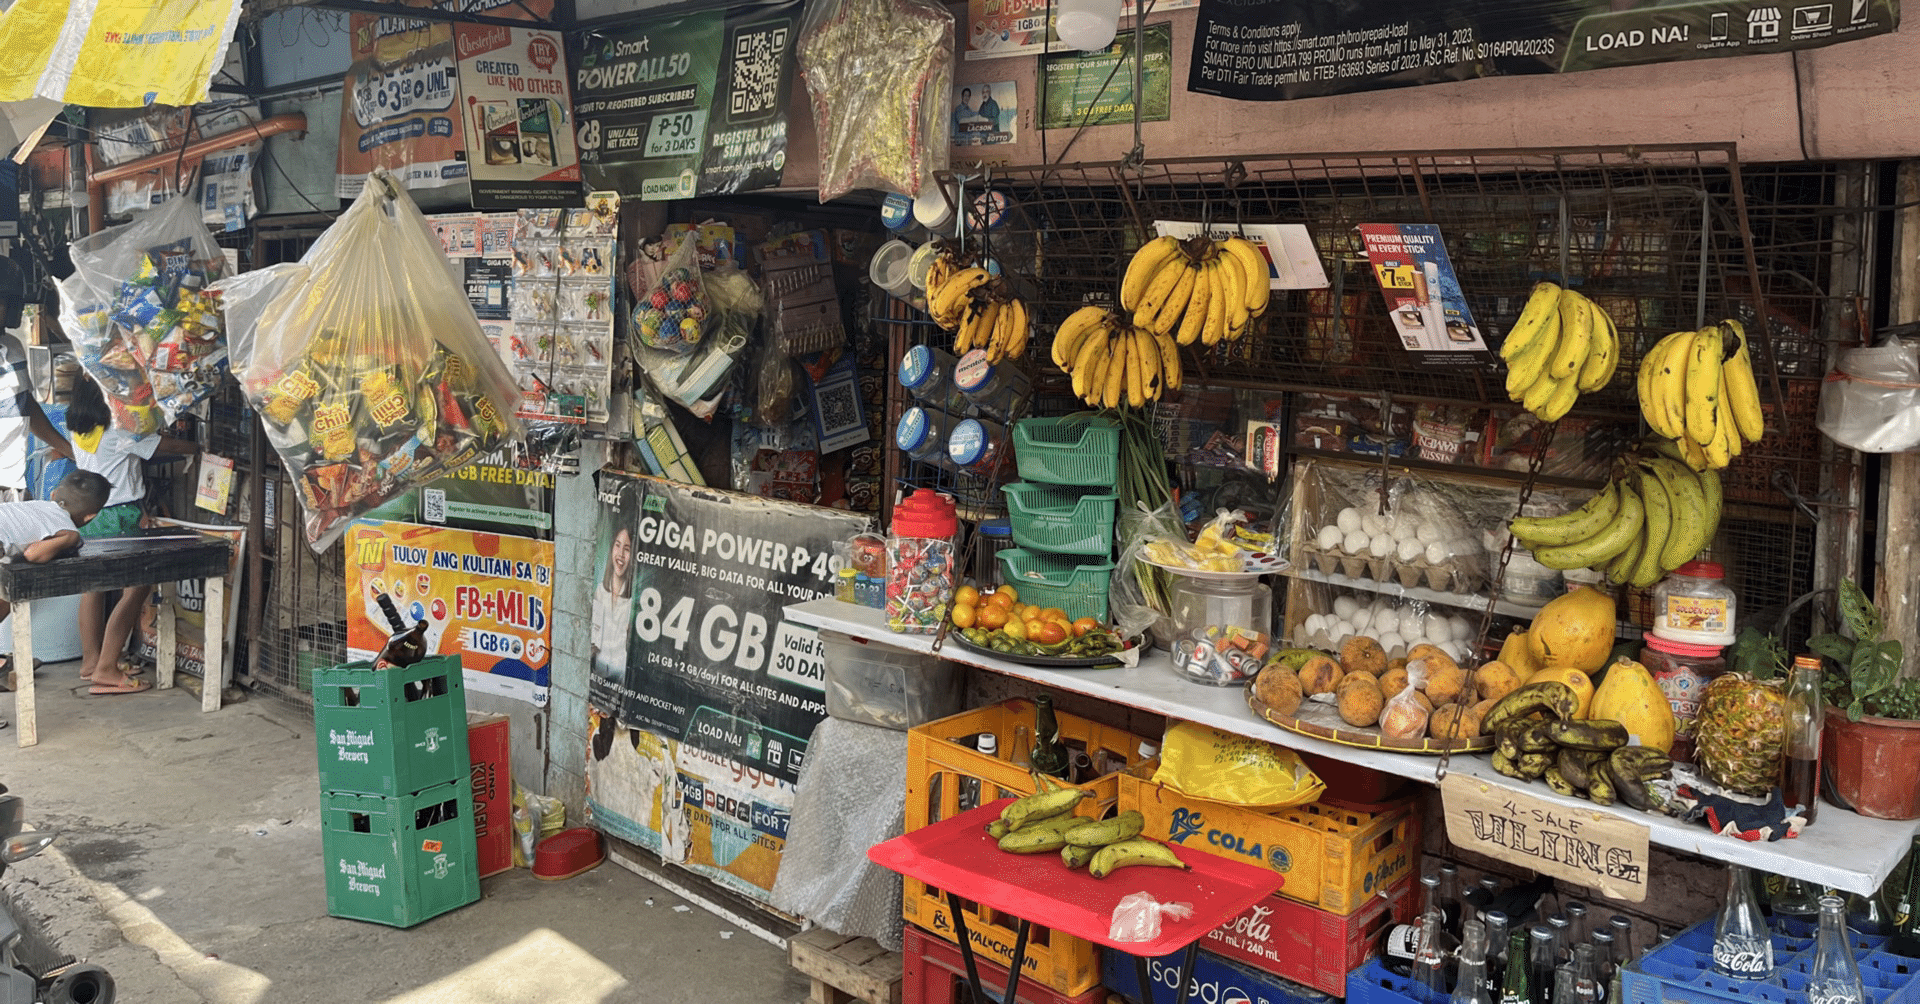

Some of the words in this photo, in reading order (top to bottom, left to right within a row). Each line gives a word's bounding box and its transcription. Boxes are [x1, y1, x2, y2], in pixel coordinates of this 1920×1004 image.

[1208, 20, 1231, 37] Terms
[1232, 25, 1239, 38] &
[1240, 25, 1280, 39] Conditions
[1281, 20, 1302, 37] apply.
[1586, 30, 1645, 52] LOAD
[1651, 25, 1689, 45] NA!
[1790, 33, 1810, 41] Online
[1811, 30, 1833, 39] Shops
[458, 27, 507, 56] Chesterfield
[533, 43, 551, 57] TRY
[615, 35, 650, 58] Smart
[1203, 50, 1235, 68] SMART
[1235, 56, 1256, 70] BRO
[1257, 53, 1297, 69] UNLIDATA
[1298, 52, 1312, 66] 799
[1313, 47, 1345, 64] PROMO
[1346, 48, 1363, 60] runs
[1364, 44, 1382, 58] from
[1382, 40, 1402, 58] April
[1410, 38, 1418, 52] to
[1419, 36, 1437, 54] May
[1437, 32, 1450, 48] 31,
[1451, 27, 1475, 46] 2023.
[1205, 36, 1219, 50] For
[1220, 41, 1240, 54] more
[1241, 41, 1257, 54] info
[1257, 41, 1273, 54] visit
[1726, 40, 1741, 49] App
[1747, 37, 1779, 46] Retailers
[476, 60, 520, 76] CREATED
[1047, 62, 1075, 72] REGISTER
[1075, 60, 1095, 69] YOUR
[1096, 59, 1110, 67] SIM
[1143, 53, 1164, 62] STEPS
[1201, 65, 1216, 79] Per
[1216, 68, 1231, 83] DTI
[1233, 70, 1249, 85] Fair
[1251, 71, 1273, 86] Trade
[1274, 71, 1298, 88] permit
[1298, 70, 1311, 82] No.
[1313, 61, 1365, 80] FTEB-163693
[1365, 59, 1390, 75] Series
[1391, 57, 1400, 71] of
[1400, 53, 1422, 70] 2023.
[1423, 50, 1442, 66] ASC
[1443, 48, 1461, 64] Ref.
[1461, 46, 1476, 62] No.
[388, 80, 402, 111] 3
[401, 79, 412, 94] GB
[487, 75, 506, 87] LIKE
[508, 77, 525, 93] NO
[527, 78, 564, 95] OTHER
[606, 96, 647, 109] REGISTERED
[648, 88, 695, 105] SUBSCRIBERS
[1114, 104, 1135, 113] DATA
[577, 119, 601, 150] GB
[712, 128, 757, 147] REGISTER
[760, 122, 787, 138] YOUR
[967, 124, 993, 132] LACSON
[619, 136, 639, 147] TEXTS
[651, 143, 663, 153] for
[664, 141, 671, 152] 3
[672, 138, 696, 150] DAYS
[722, 146, 742, 159] SIM
[744, 140, 771, 155] NOW
[643, 185, 657, 195] LOAD
[1365, 233, 1403, 244] PREMIUM
[1403, 234, 1434, 244] QUALITY
[1368, 244, 1378, 252] IN
[1378, 244, 1402, 253] EVERY
[1402, 244, 1426, 254] STICK
[958, 357, 986, 373] mentos
[371, 394, 405, 421] Chili
[382, 407, 408, 424] Black
[314, 412, 351, 433] Chili
[1418, 435, 1459, 454] RAMEN
[458, 465, 478, 481] GB
[480, 466, 513, 484] FREE
[515, 470, 555, 489] DATA!
[597, 491, 622, 507] mart
[638, 517, 695, 552] GIGA
[701, 528, 787, 573] POWER
[392, 545, 428, 567] TULOY
[432, 550, 458, 570] ANG
[462, 554, 512, 577] KULITAN
[515, 561, 533, 581] SA
[535, 565, 551, 584] FB!
[636, 551, 666, 571] GREAT
[667, 556, 699, 577] VALUE,
[701, 567, 717, 580] BIG
[719, 569, 744, 585] DATA
[746, 576, 765, 591] FOR
[767, 580, 785, 595] ALL
[786, 584, 813, 602] YOUR
[1675, 605, 1703, 615] GOLDEN
[1704, 606, 1720, 616] COIN
[635, 587, 696, 650] 84
[699, 604, 768, 671] GB
[479, 633, 498, 651] GB
[784, 633, 813, 655] Valid
[776, 652, 794, 673] 30
[661, 656, 674, 669] GB
[720, 672, 739, 689] FOR
[739, 679, 756, 694] ALL
[756, 683, 777, 702] SITES
[778, 690, 800, 708] AND
[800, 697, 826, 716] APPS
[635, 692, 649, 703] AND
[649, 697, 672, 712] POCKET
[672, 704, 686, 716] WIFI
[329, 728, 348, 745] San
[347, 729, 374, 749] Miguel
[697, 722, 723, 740] LOAD
[724, 731, 743, 747] NA!
[337, 746, 369, 765] Brewery
[488, 762, 496, 801] VINO
[693, 810, 714, 827] DATA
[715, 820, 731, 835] FOR
[733, 827, 749, 841] ALL
[751, 834, 776, 851] SITES
[754, 811, 779, 830] FOR
[1168, 807, 1205, 844] RC
[1207, 829, 1263, 860] COLA
[1464, 809, 1641, 884] ULING
[339, 858, 358, 876] San
[357, 859, 386, 881] Miguel
[347, 875, 380, 896] Brewery
[1207, 929, 1224, 941] 237
[1225, 935, 1241, 949] mL
[1246, 940, 1264, 956] 240
[1265, 948, 1281, 963] mL
